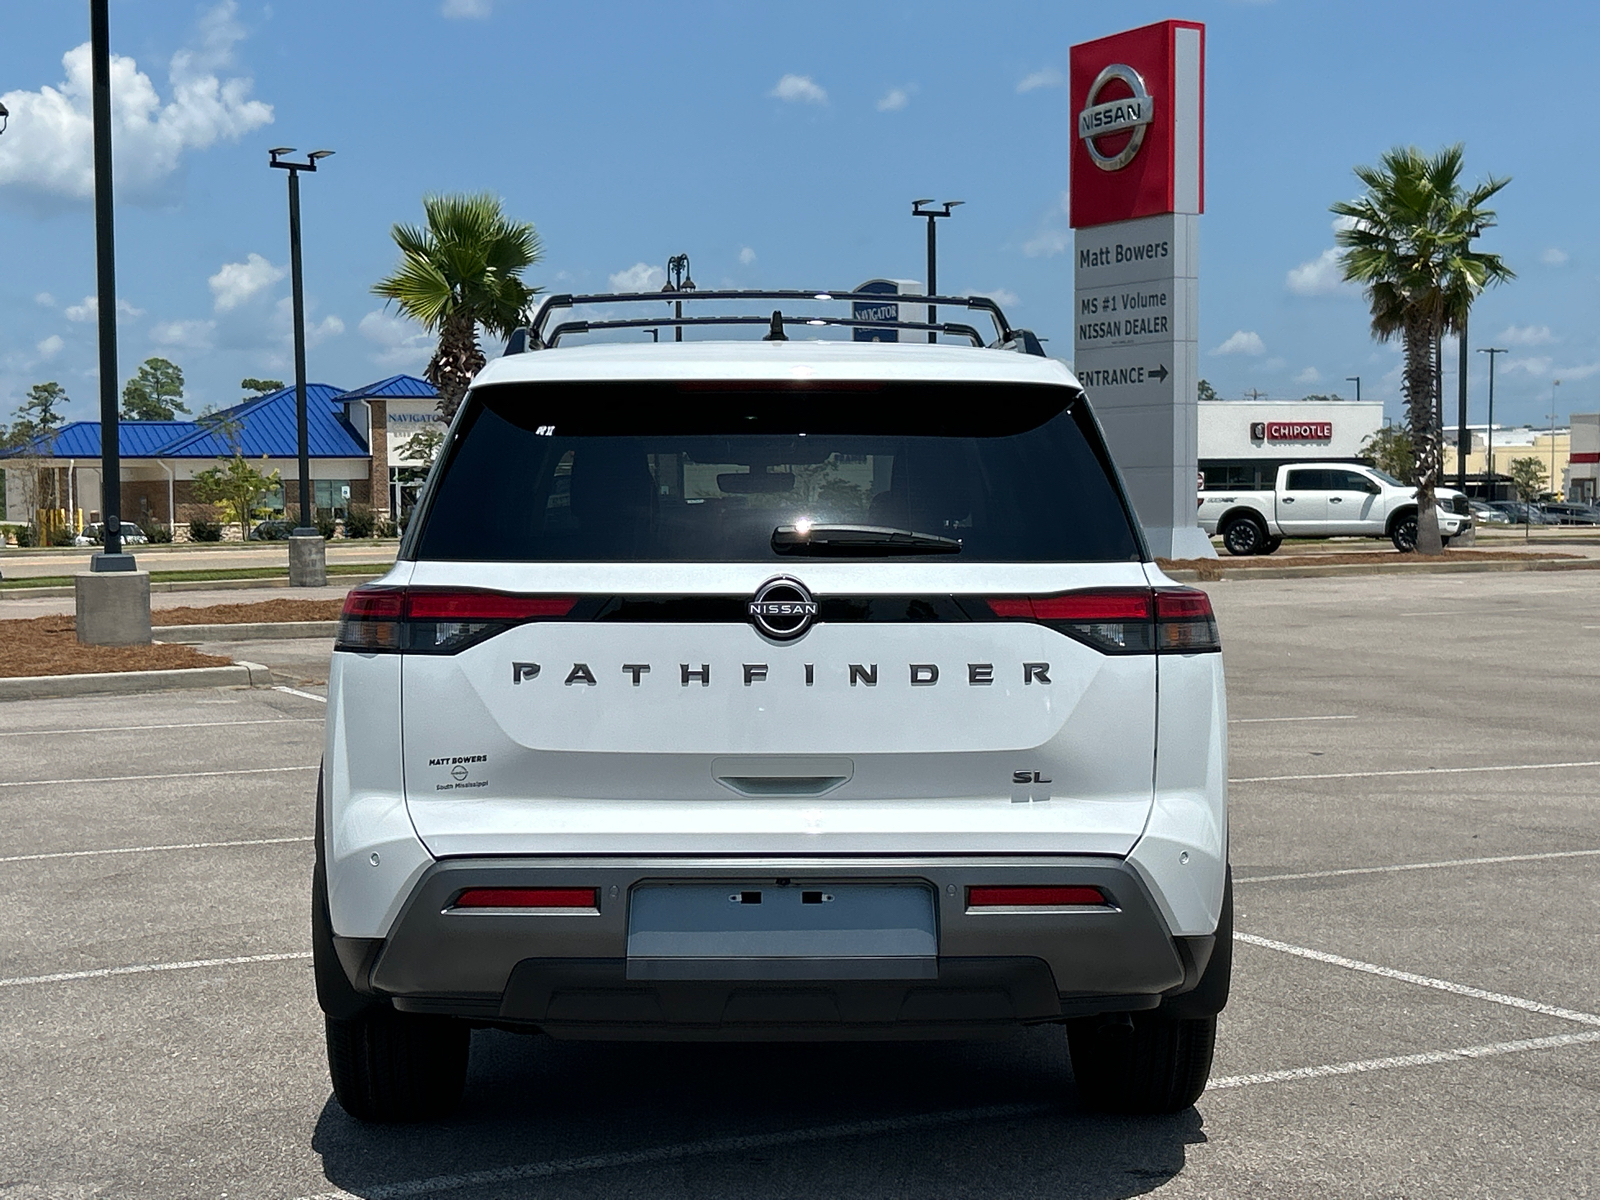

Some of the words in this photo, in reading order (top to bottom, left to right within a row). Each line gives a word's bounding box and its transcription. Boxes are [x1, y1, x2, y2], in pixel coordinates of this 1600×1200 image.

[1082, 103, 1141, 131] NISSAN
[1080, 247, 1111, 268] Matt
[1115, 241, 1168, 264] Bowers
[1081, 298, 1098, 315] MS
[1102, 296, 1117, 312] #1
[1121, 292, 1167, 310] Volume
[855, 305, 897, 321] NAVIGATOR
[1079, 321, 1121, 340] NISSAN
[1125, 316, 1168, 336] DEALER
[1078, 367, 1144, 386] ENTRANCE
[388, 414, 442, 423] NAVIGATO
[1271, 425, 1331, 437] CHIPOTLE
[750, 604, 816, 614] NISSAN
[512, 662, 1051, 687] PATHFINDER
[429, 758, 450, 766] MATT
[452, 755, 487, 764] BOWERS
[1012, 770, 1052, 784] SL
